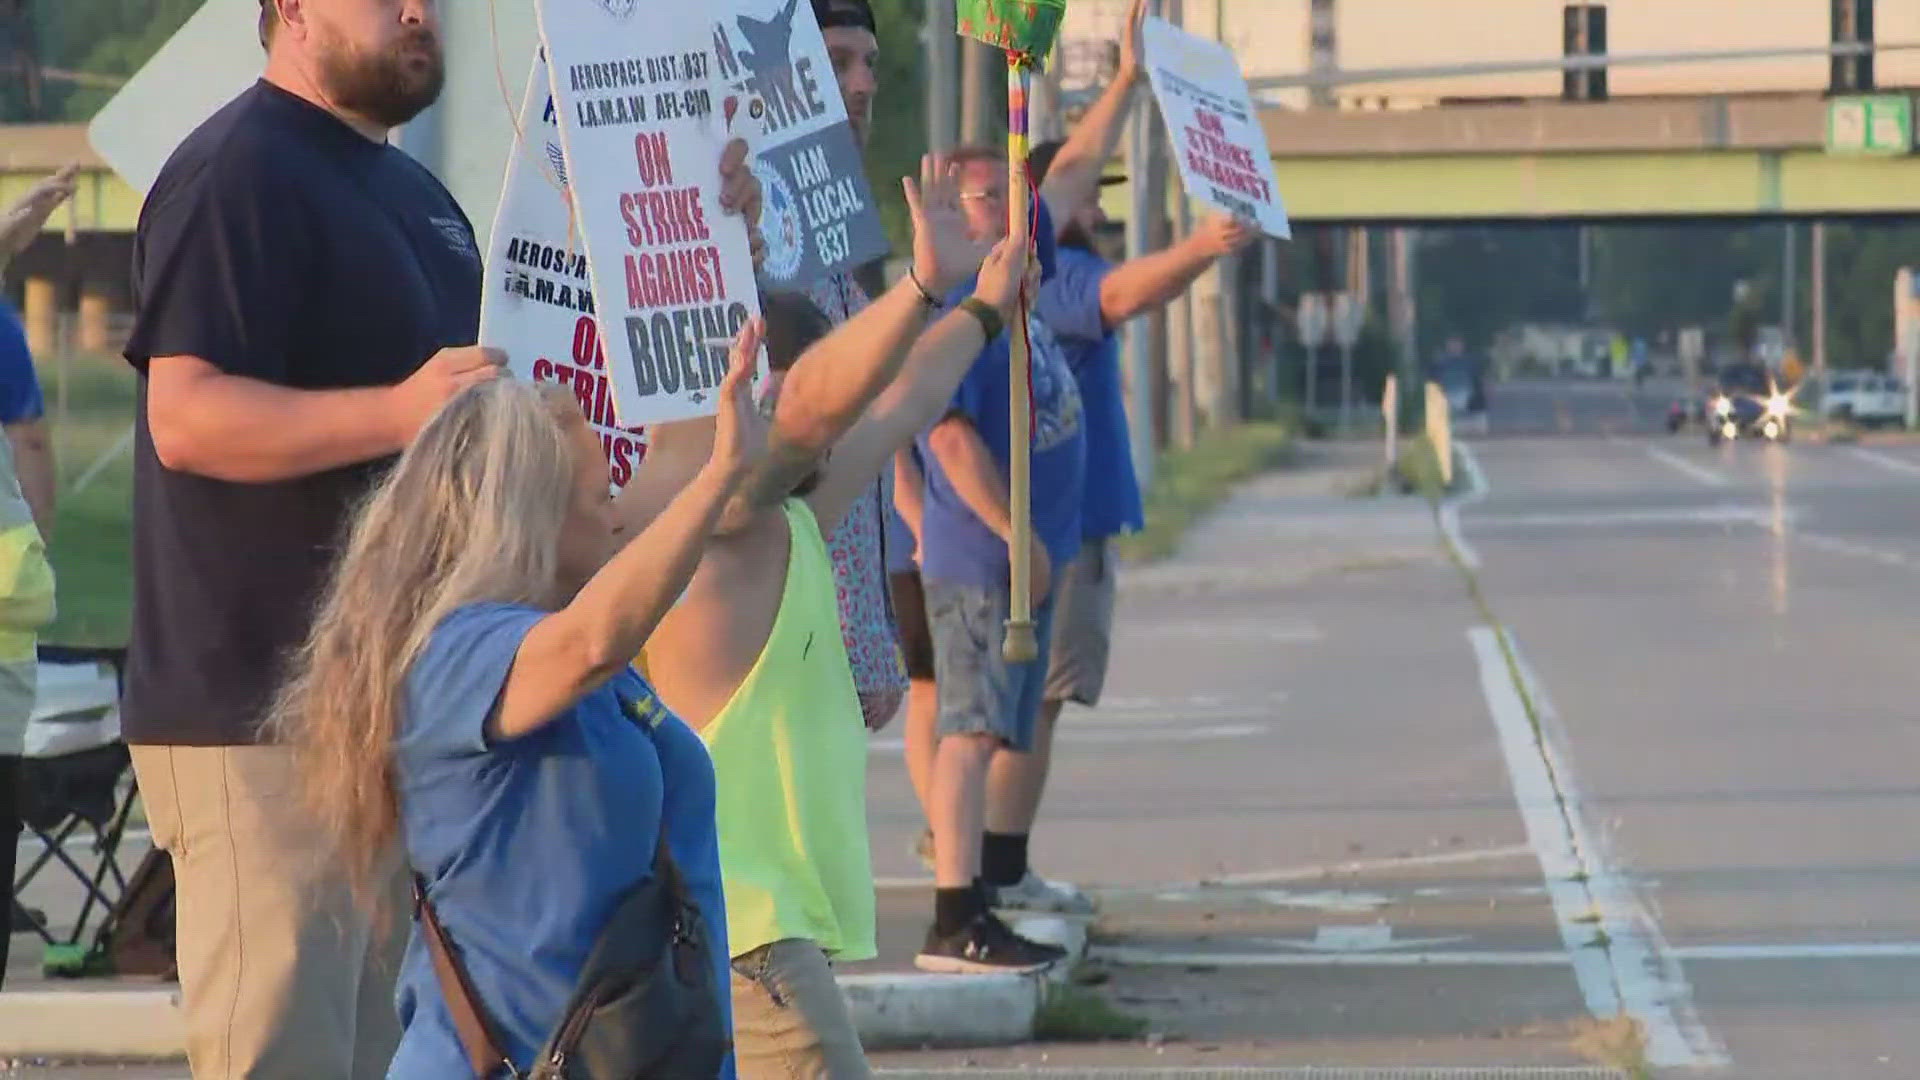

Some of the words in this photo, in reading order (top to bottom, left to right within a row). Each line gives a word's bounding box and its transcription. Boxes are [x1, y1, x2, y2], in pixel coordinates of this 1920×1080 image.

[570, 59, 645, 91] AEROSPACE
[646, 55, 681, 84] DIST.
[683, 51, 708, 80] 837
[635, 131, 673, 187] ON
[790, 143, 832, 190] IAM
[1183, 125, 1258, 174] STRIKE
[802, 175, 864, 230] LOCAL
[1187, 149, 1271, 205] AGAINST
[620, 186, 710, 248] STRIKE
[506, 237, 587, 280] AEROSPA
[815, 222, 850, 266] 837
[624, 246, 727, 309] AGAINST
